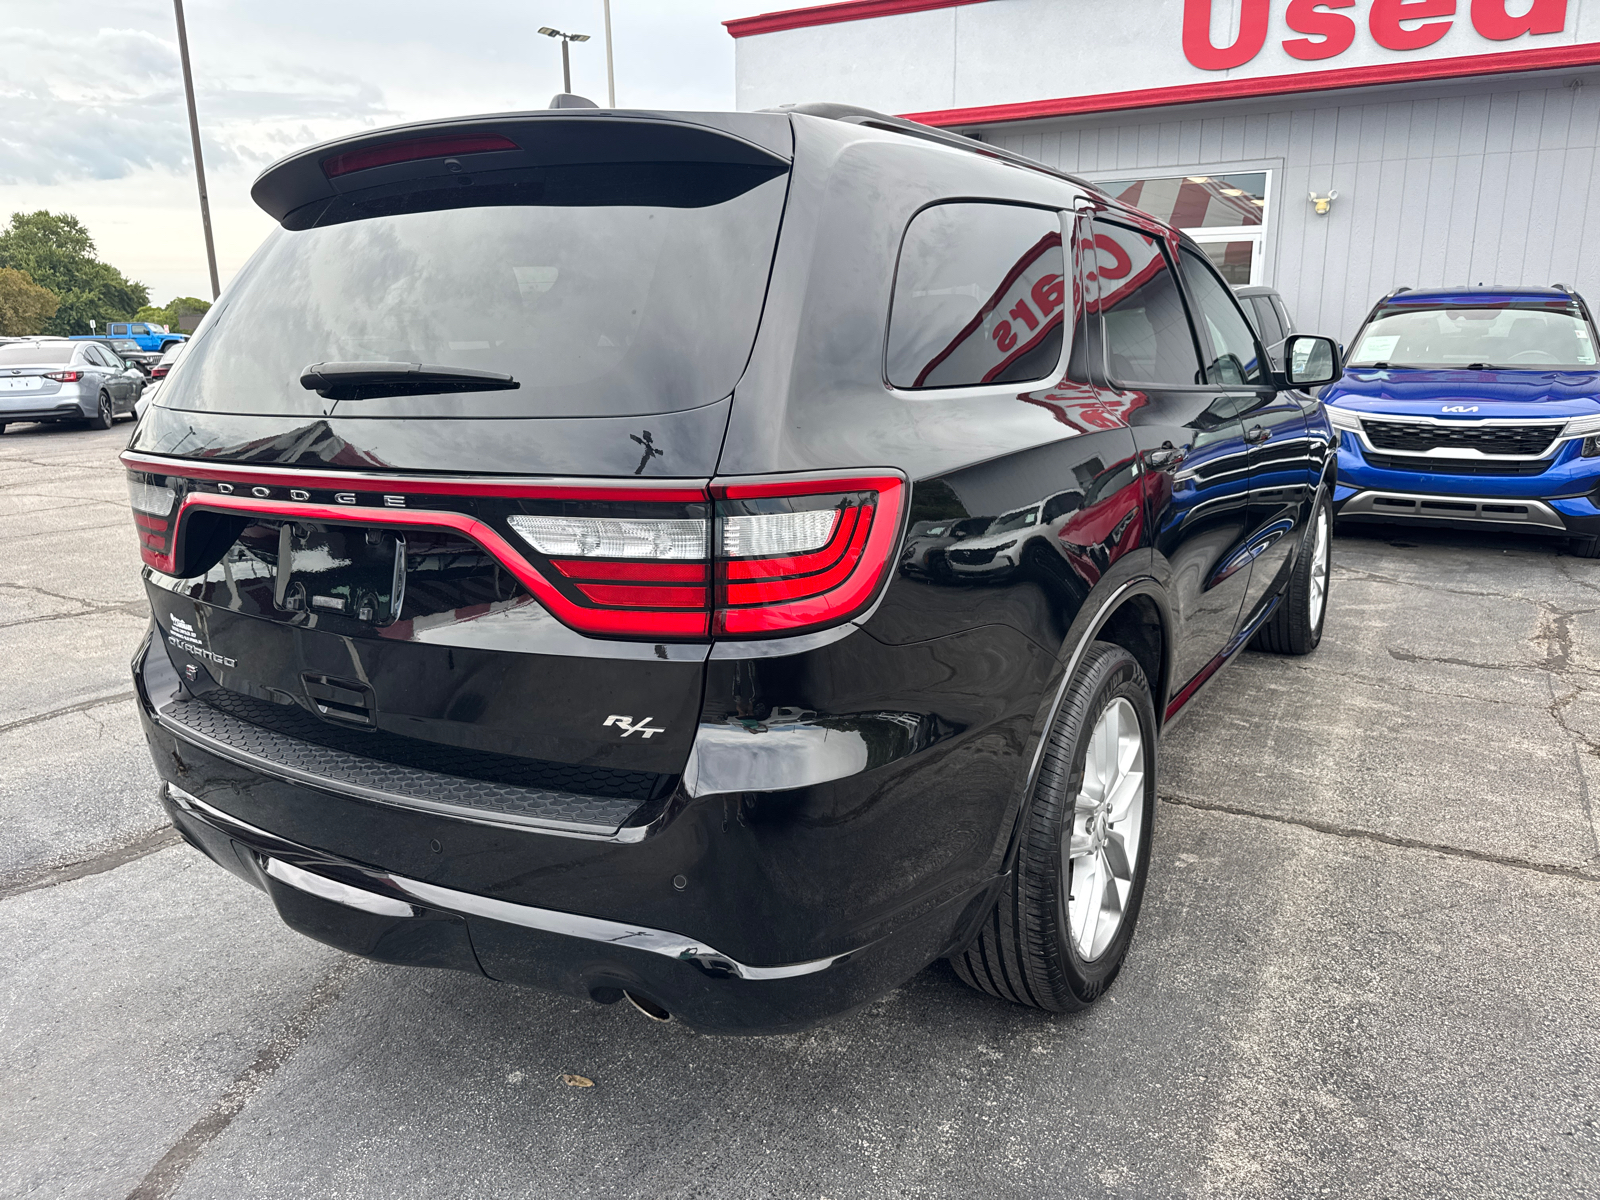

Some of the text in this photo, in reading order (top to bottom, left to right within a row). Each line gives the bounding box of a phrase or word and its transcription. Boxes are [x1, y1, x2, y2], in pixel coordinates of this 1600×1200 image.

[217, 482, 406, 507] DODGE
[168, 636, 238, 668] DURANGO
[602, 714, 666, 738] R/T
